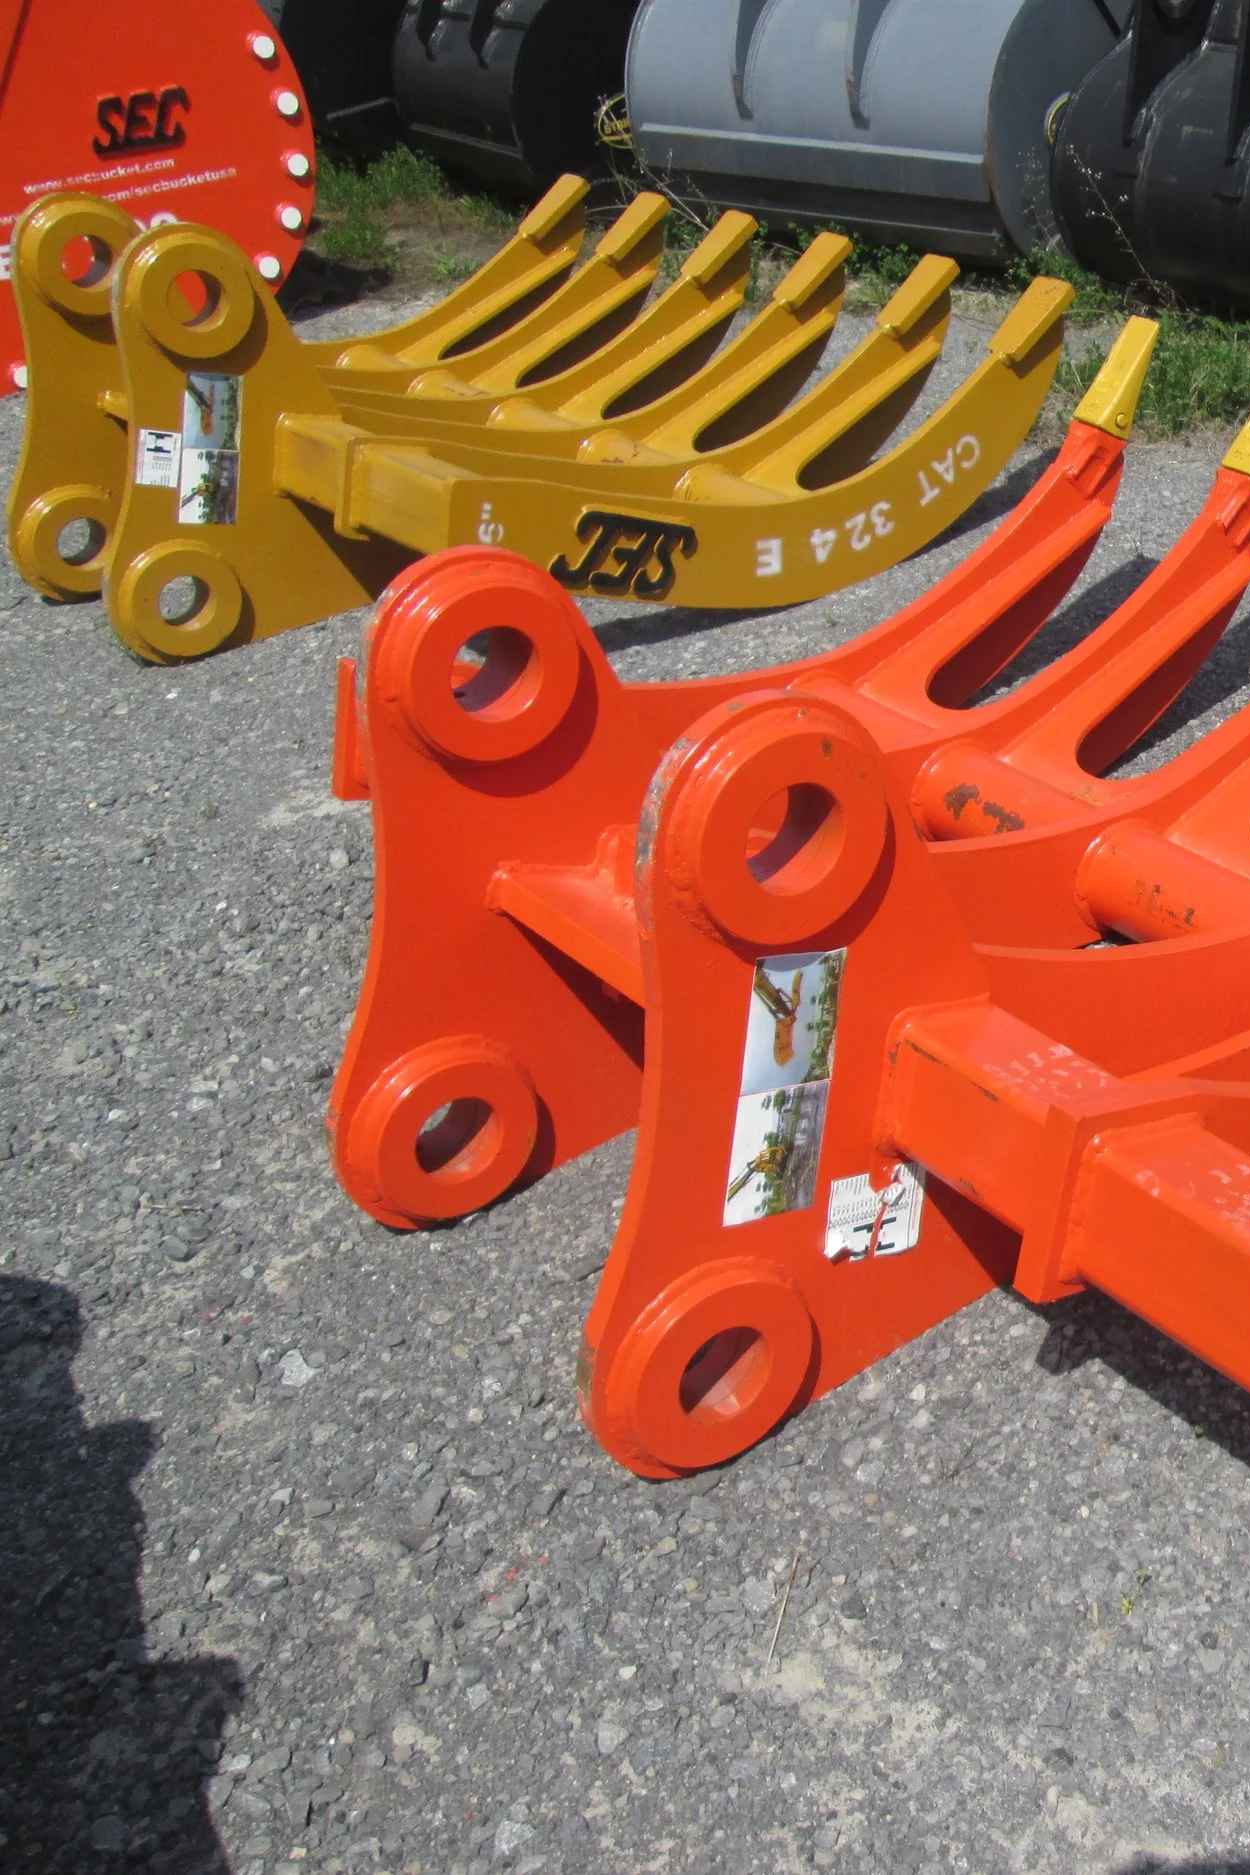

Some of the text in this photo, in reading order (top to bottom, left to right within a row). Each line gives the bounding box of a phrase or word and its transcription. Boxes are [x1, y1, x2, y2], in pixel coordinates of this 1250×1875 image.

[92, 86, 190, 158] SEC
[23, 157, 175, 194] www.secbucket.com
[755, 434, 981, 578] CAT 324 E
[550, 506, 699, 600] SEC
